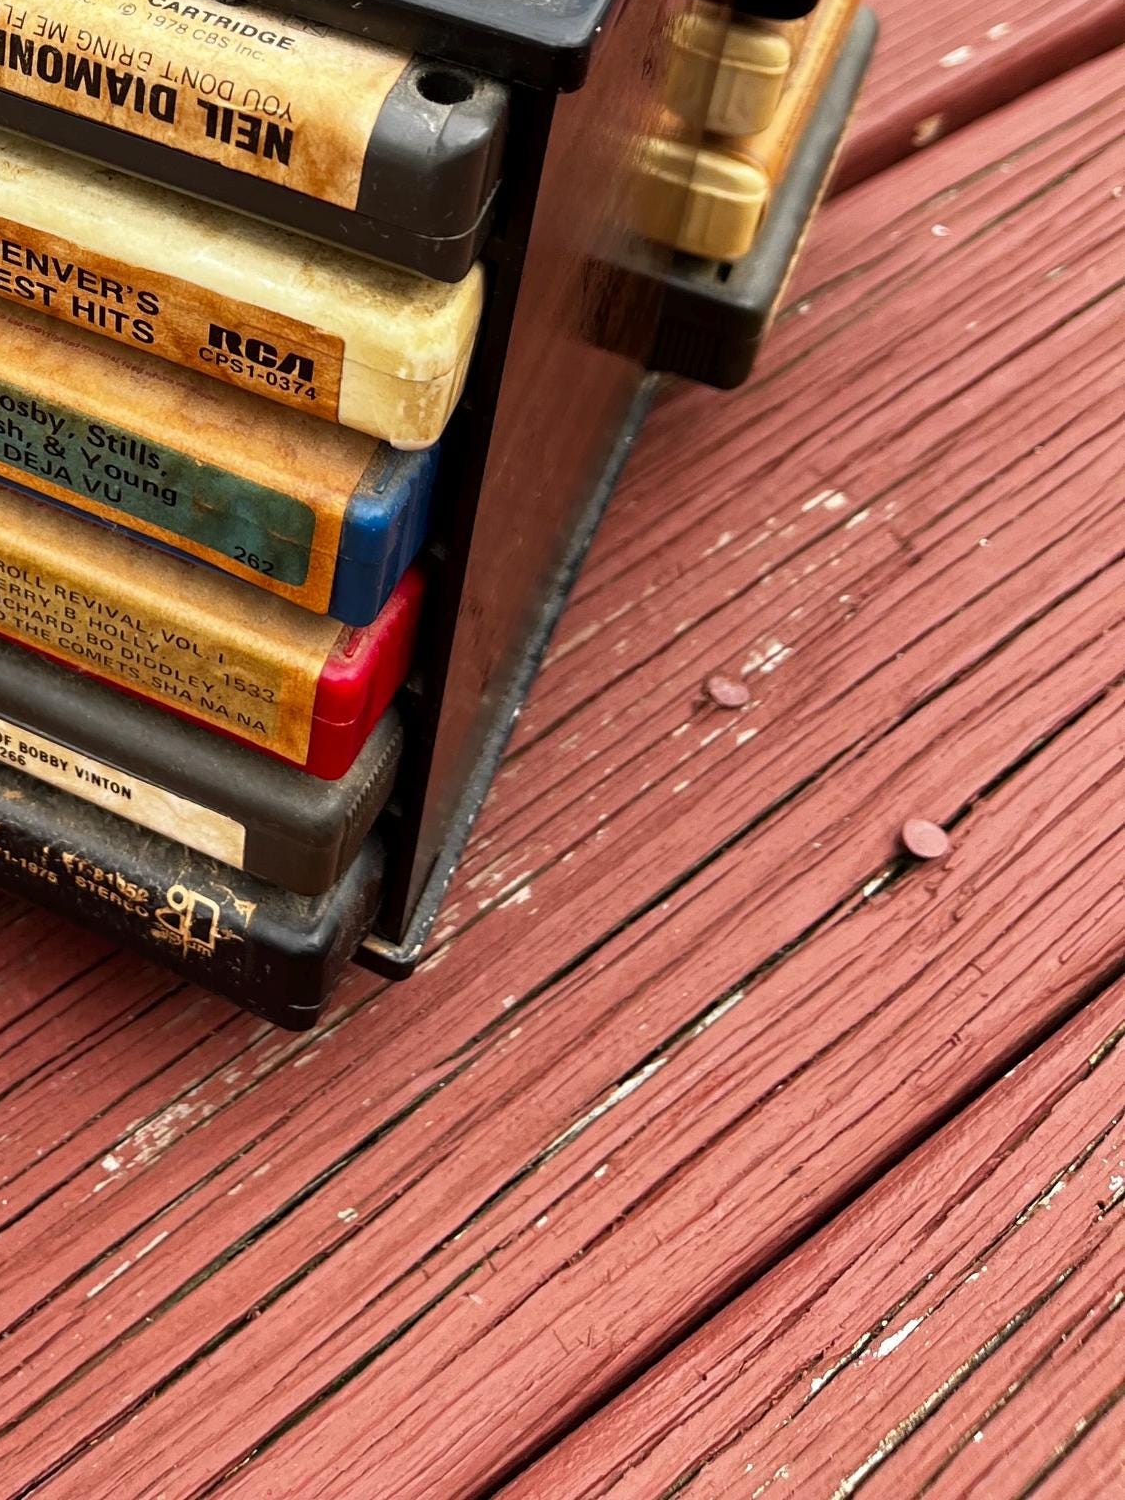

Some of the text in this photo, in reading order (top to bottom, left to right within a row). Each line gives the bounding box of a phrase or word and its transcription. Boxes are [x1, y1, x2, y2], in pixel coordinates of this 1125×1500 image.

[32, 13, 70, 43] ME
[76, 28, 153, 72] BRING
[147, 11, 188, 36] 1978
[192, 28, 230, 50] CBS
[235, 42, 267, 63] Inc.
[158, 59, 236, 102] DON'T
[242, 87, 294, 124] YOU
[195, 96, 296, 168] NEIL
[71, 294, 156, 346] HITS
[197, 345, 319, 402] CPS1-0374
[207, 322, 316, 384] RCA
[1, 441, 125, 505] DEJA VU
[41, 436, 67, 461] &
[79, 445, 179, 507] Young
[86, 422, 169, 478] Stills,
[232, 545, 276, 578] 262
[64, 606, 83, 624] B.
[85, 631, 114, 651] BO
[161, 627, 211, 661] VOL.
[12, 615, 52, 642] THE
[150, 675, 194, 702] SHA
[200, 695, 230, 718] NA
[236, 712, 268, 735] NA
[222, 673, 275, 705] 1533
[18, 741, 69, 773] BOBBY
[74, 764, 133, 800] VINTON
[74, 874, 150, 917] STEREO
